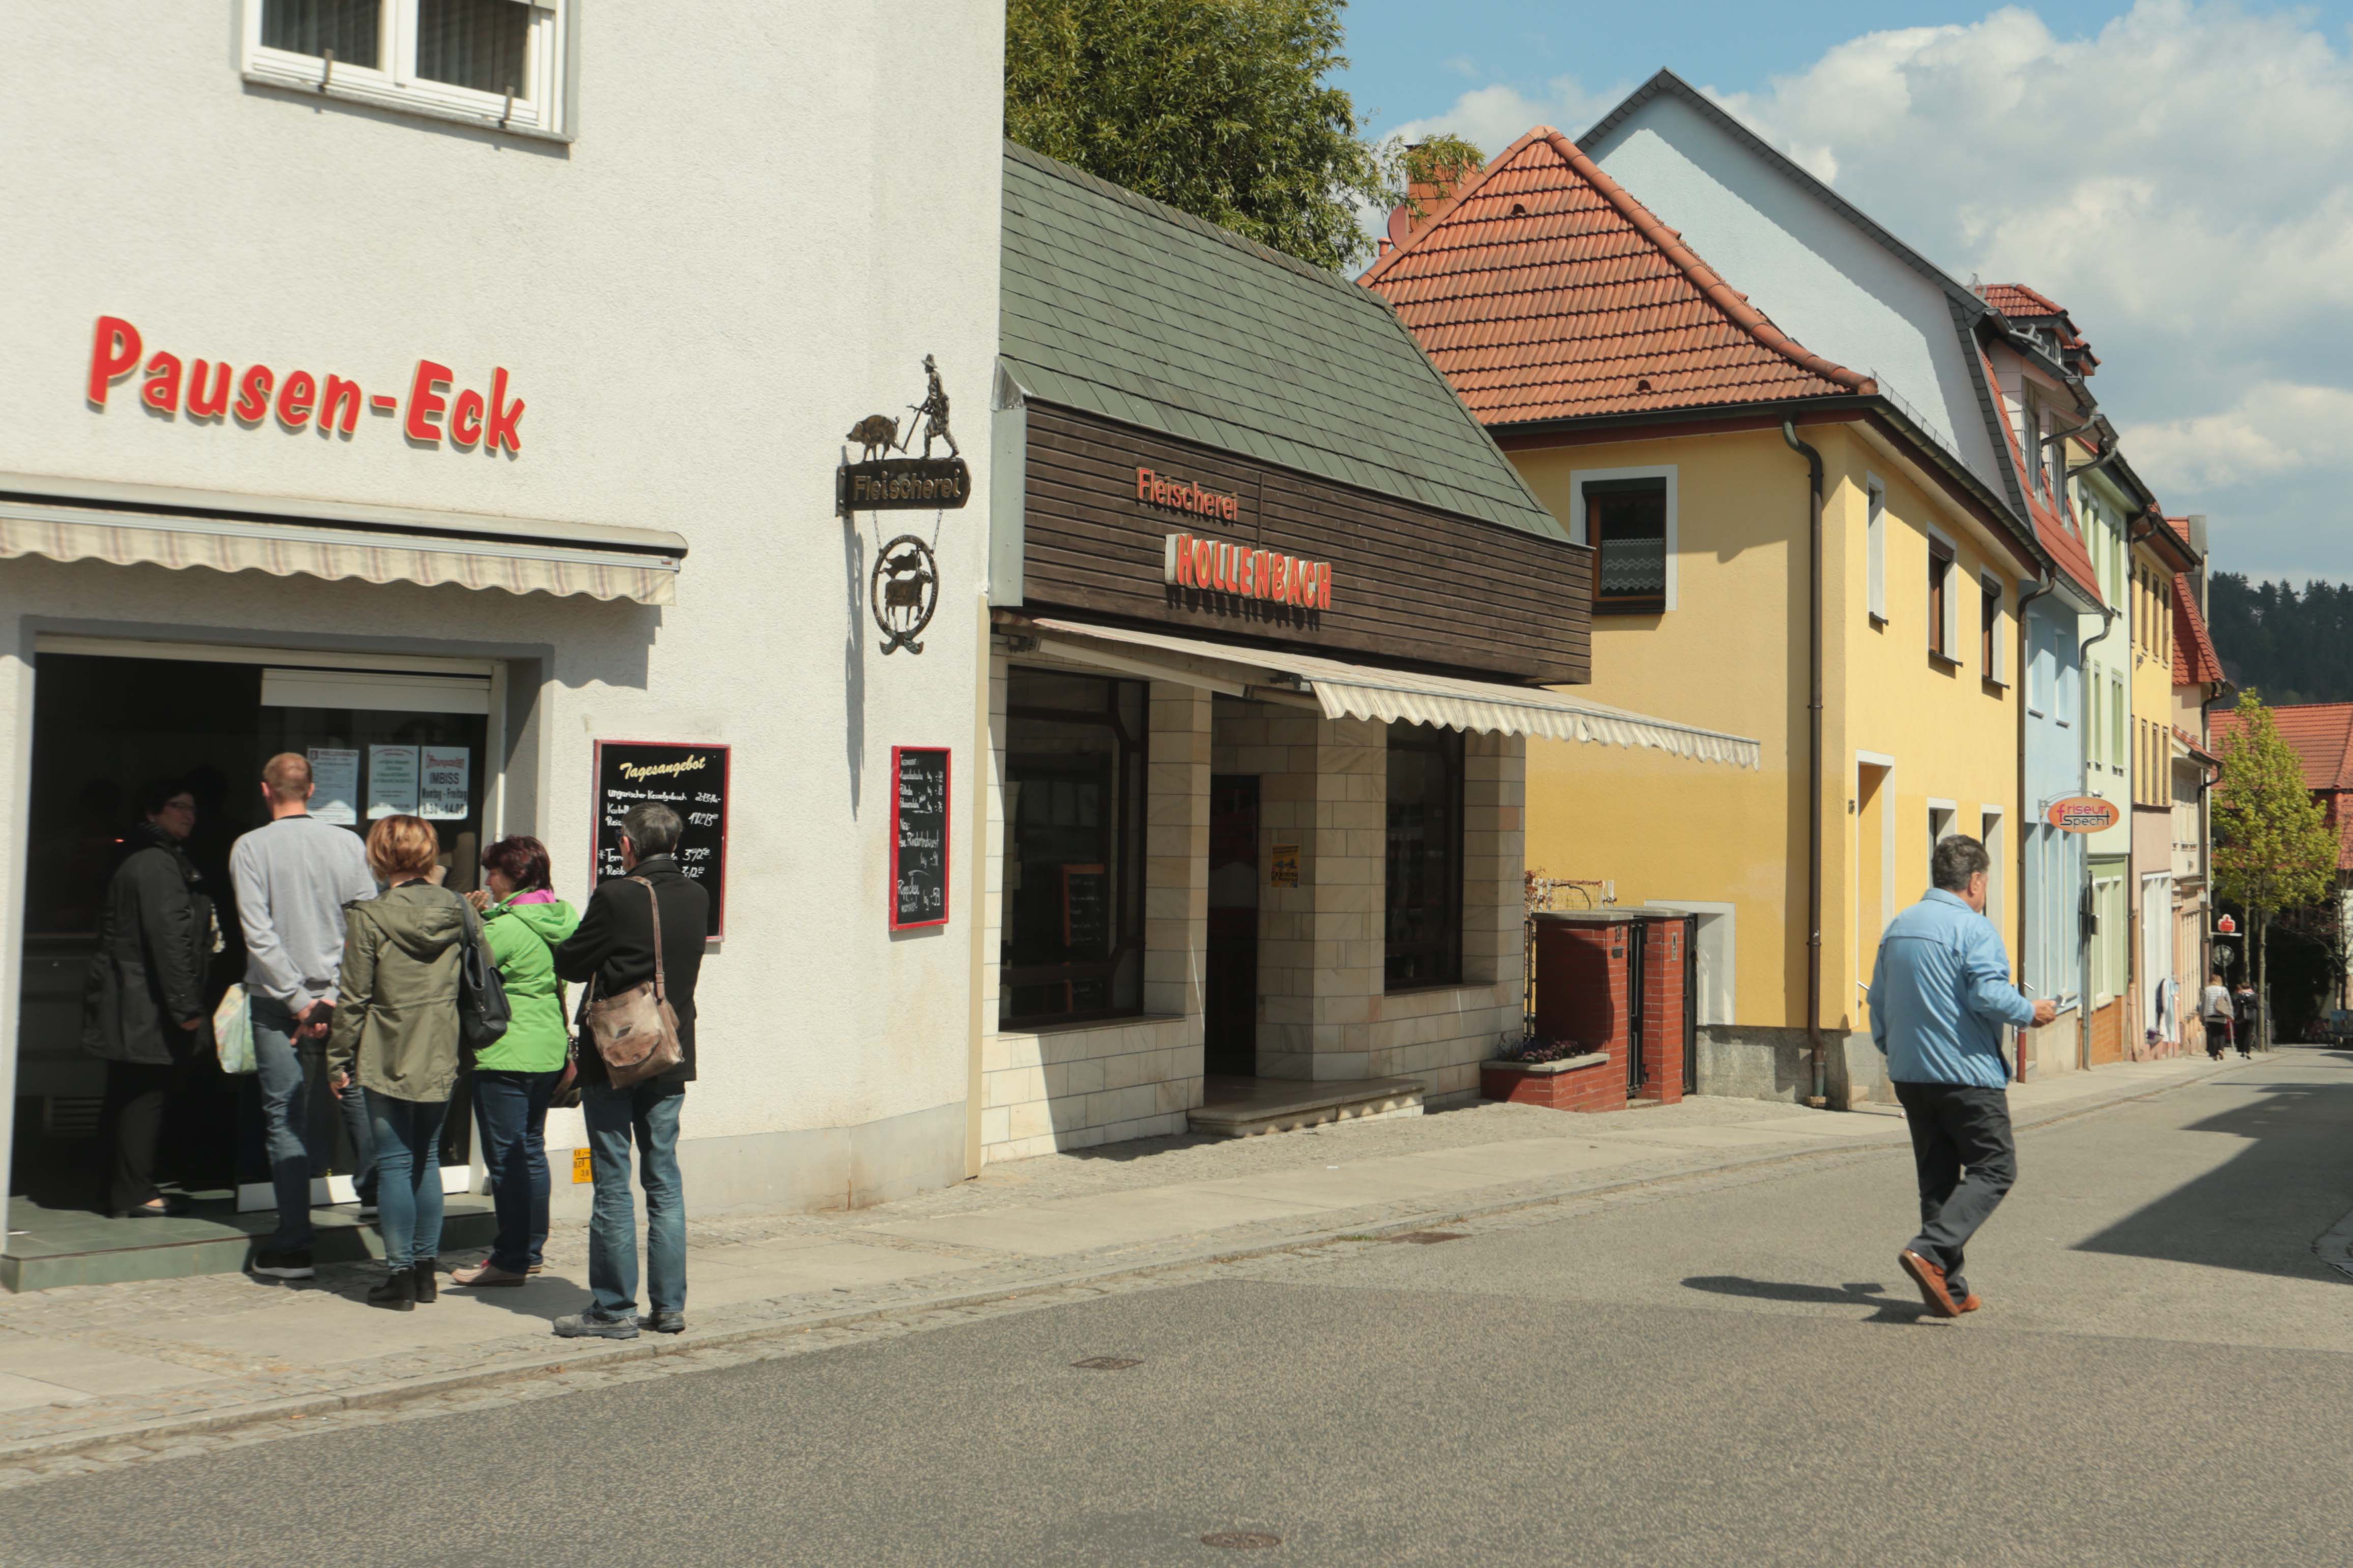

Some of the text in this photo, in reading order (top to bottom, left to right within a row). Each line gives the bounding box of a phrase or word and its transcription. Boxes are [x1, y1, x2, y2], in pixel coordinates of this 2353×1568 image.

[86, 315, 525, 453] Pausen-Eck
[854, 468, 961, 500] Fleischerei
[1136, 467, 1237, 521] Fleischerei
[1176, 533, 1331, 609] HOLLENBACH
[430, 772, 459, 784] IMBISS
[620, 754, 706, 782] Tagesangebot
[422, 787, 442, 801] Montag
[447, 788, 467, 802] Freitag
[2056, 804, 2106, 823] friseur
[2059, 810, 2110, 830] Specht
